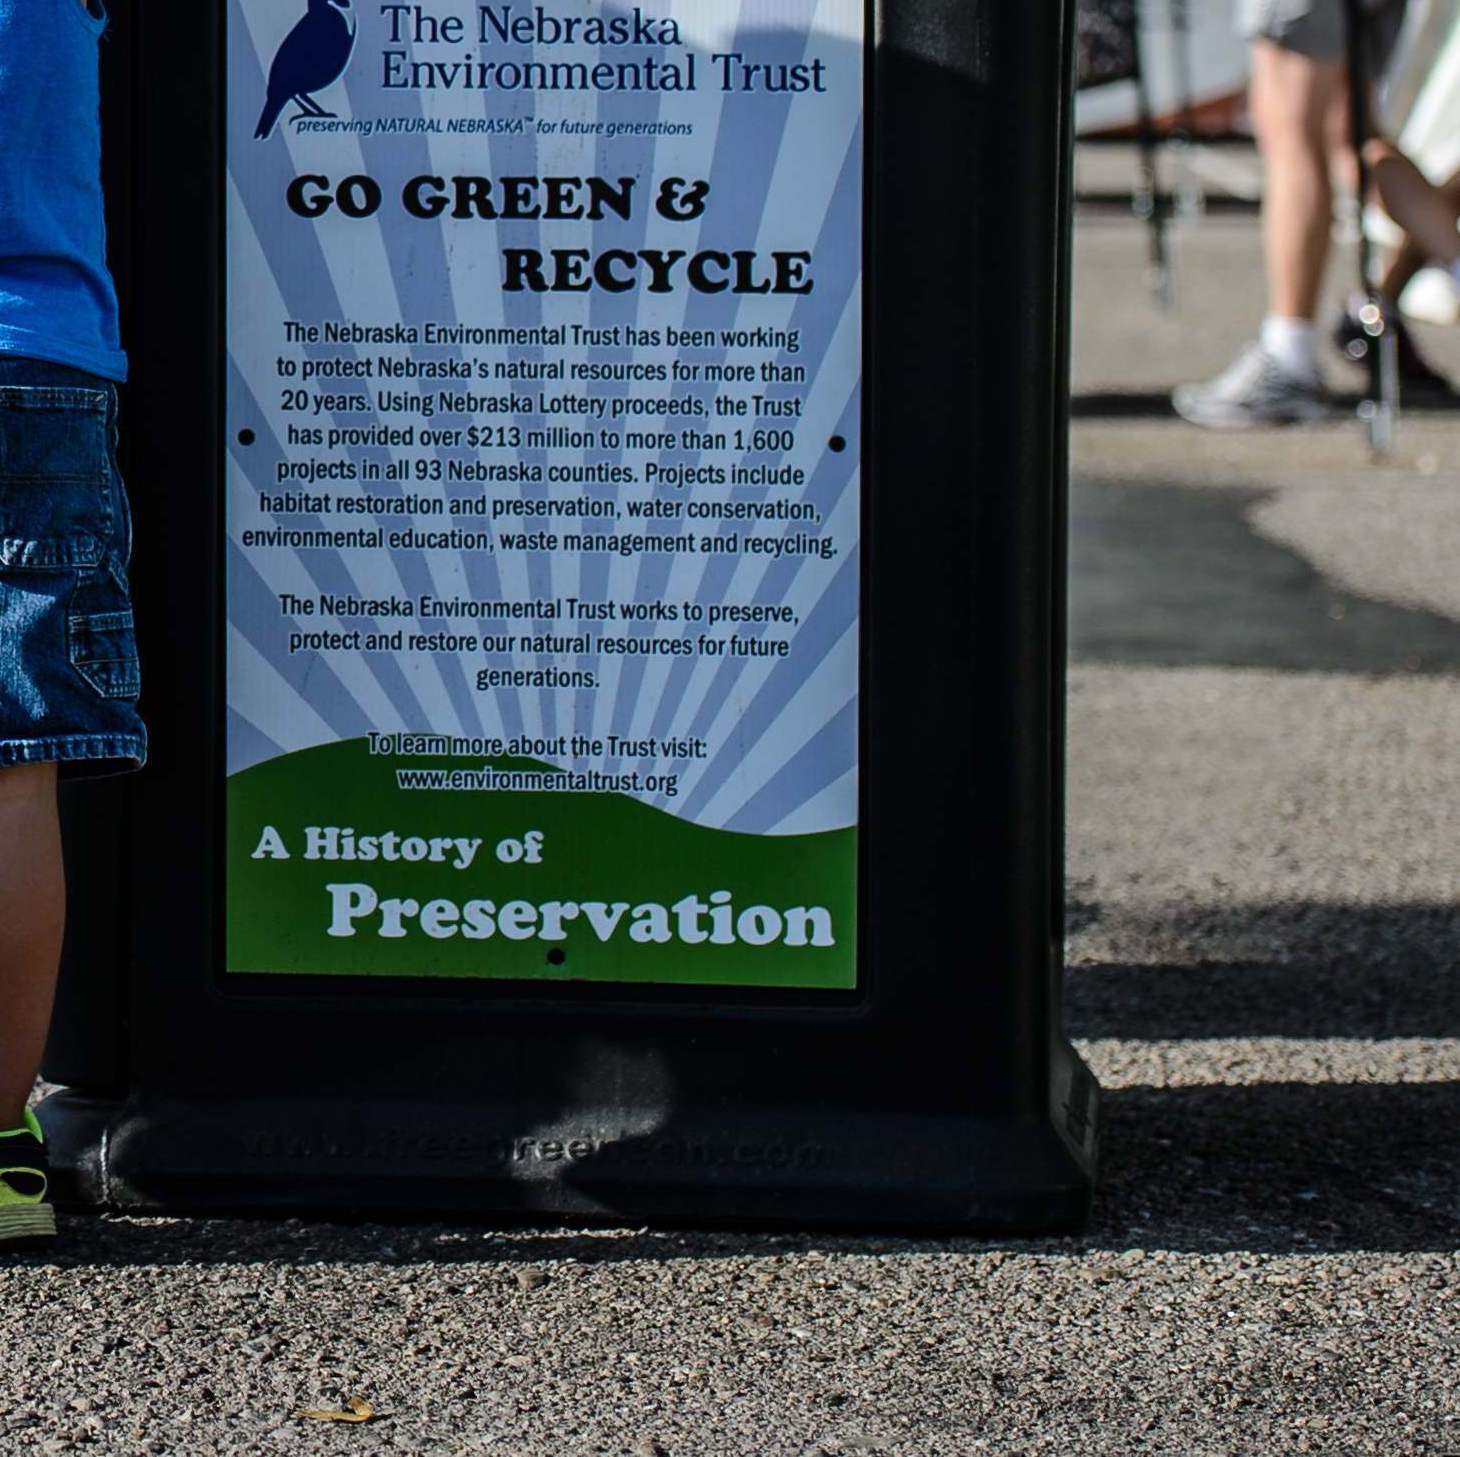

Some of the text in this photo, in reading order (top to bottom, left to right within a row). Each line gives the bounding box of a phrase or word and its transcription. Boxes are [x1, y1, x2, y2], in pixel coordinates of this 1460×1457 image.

[380, 4, 683, 46] The Nebraska
[381, 50, 827, 93] Environmental Trust
[295, 117, 373, 136] preserving
[374, 117, 444, 133] NATURAL
[536, 118, 558, 134] for
[559, 118, 604, 135] future
[605, 121, 693, 138] generations
[285, 174, 711, 222] GO GREEN &
[501, 247, 814, 296] RECYCLE
[283, 321, 800, 353] The Nebraska Environmental Trust has been working
[276, 356, 297, 377] to
[302, 357, 373, 381] protect
[494, 358, 565, 380] natural
[570, 363, 667, 381] resources
[671, 359, 700, 381] for
[704, 365, 756, 382] more
[760, 361, 805, 383] than
[280, 389, 802, 419] 20 years. Using Nebraska Lottery proceeds, the Trust
[287, 423, 794, 454] has provided over $213 million to more than 1,600
[277, 457, 806, 489] projects in all 93 Nebraska counties. Projects include
[259, 491, 821, 523] habitat restoration and preservation, water conservation,
[242, 525, 838, 560] environmental education, waste management and recycling.
[278, 593, 799, 627] The Nebraska Environmental Trust works to preserve,
[289, 629, 789, 657] protect and restore our natural resources for future
[475, 666, 600, 692] generations.
[367, 731, 708, 759] To learn more about the Trust visit:
[397, 766, 679, 797] www.environmentaltrust.org
[250, 825, 545, 870] A History of
[325, 883, 836, 947] Preservation
